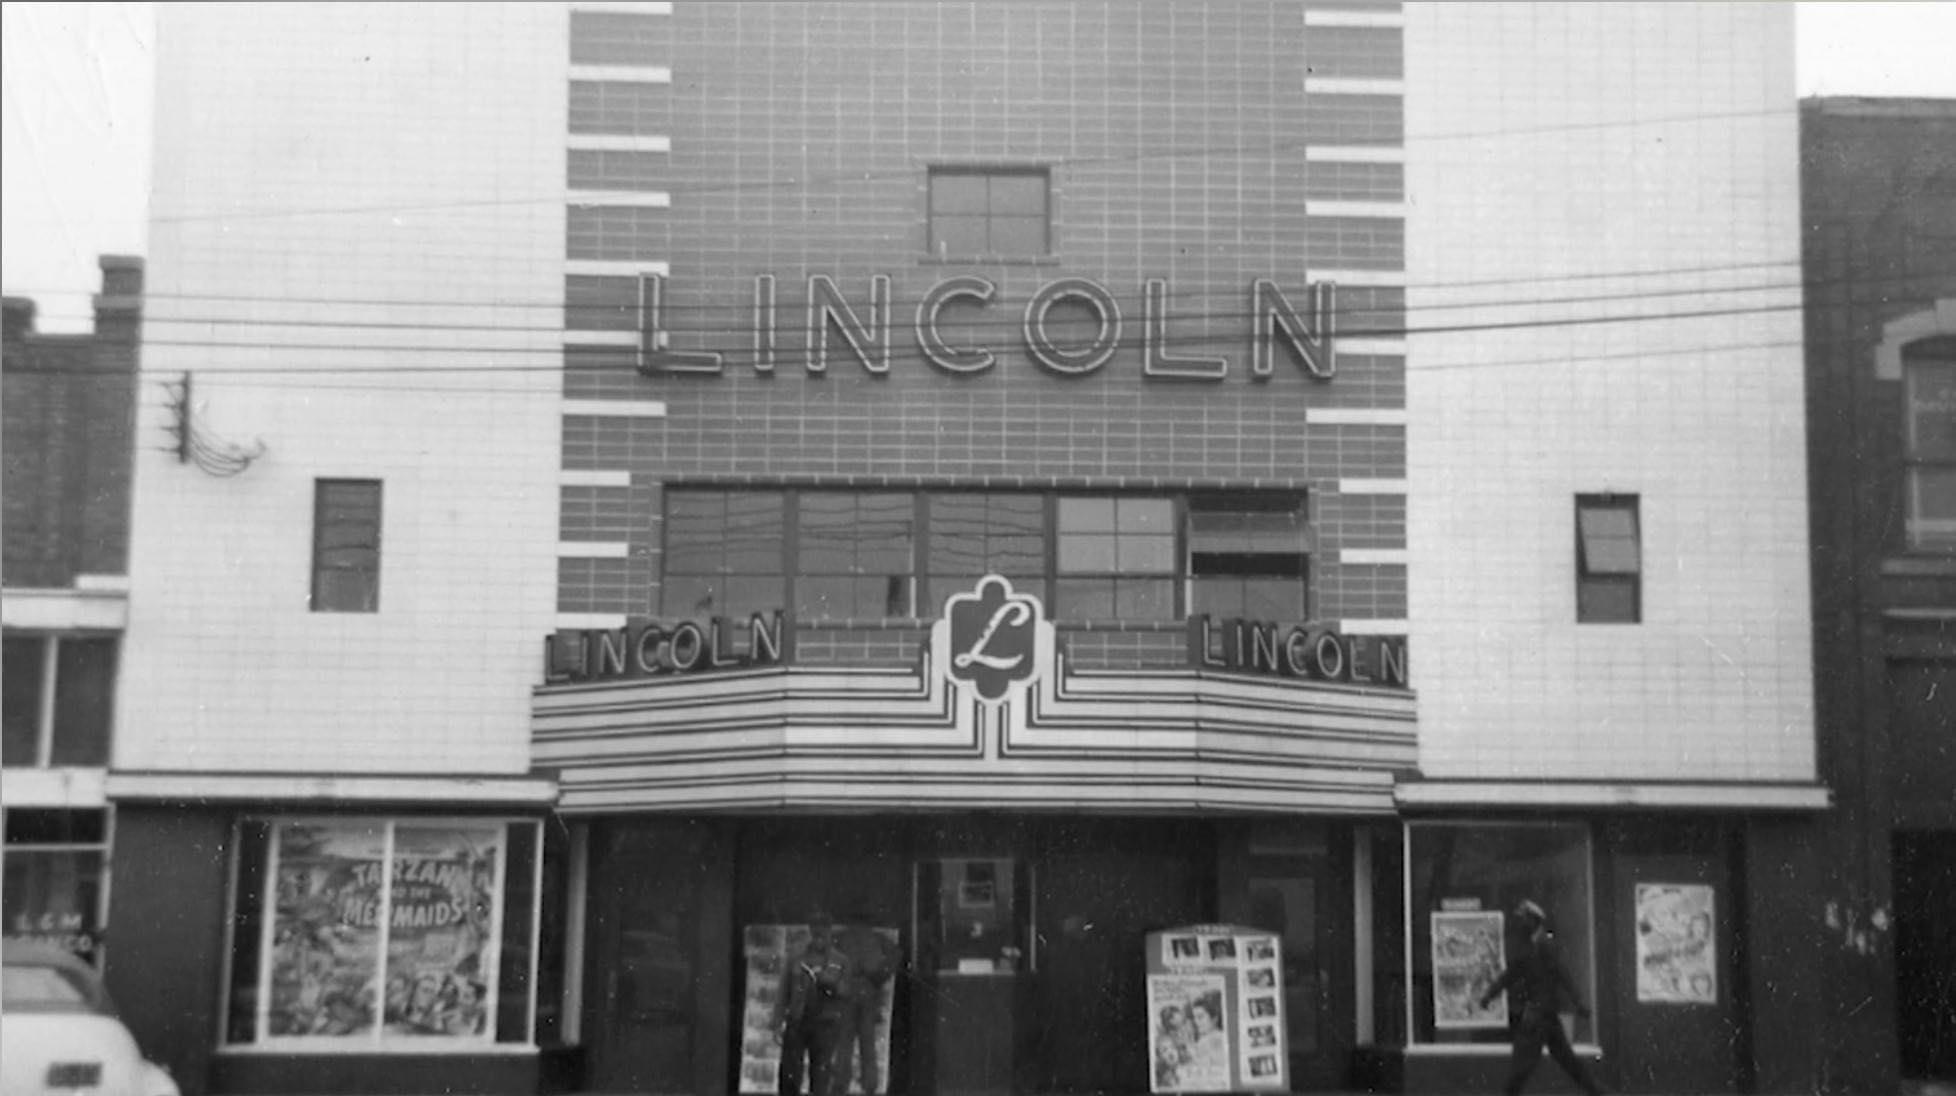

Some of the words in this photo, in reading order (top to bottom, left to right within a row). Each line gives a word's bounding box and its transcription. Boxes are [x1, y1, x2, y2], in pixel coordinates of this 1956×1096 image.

[637, 273, 1337, 378] LINCOLN
[546, 610, 784, 682] LINCOLN
[953, 600, 1031, 669] L
[1200, 614, 1406, 685] LINCOLN
[351, 858, 457, 888] TARZAN
[344, 896, 462, 927] MEMAIDS
